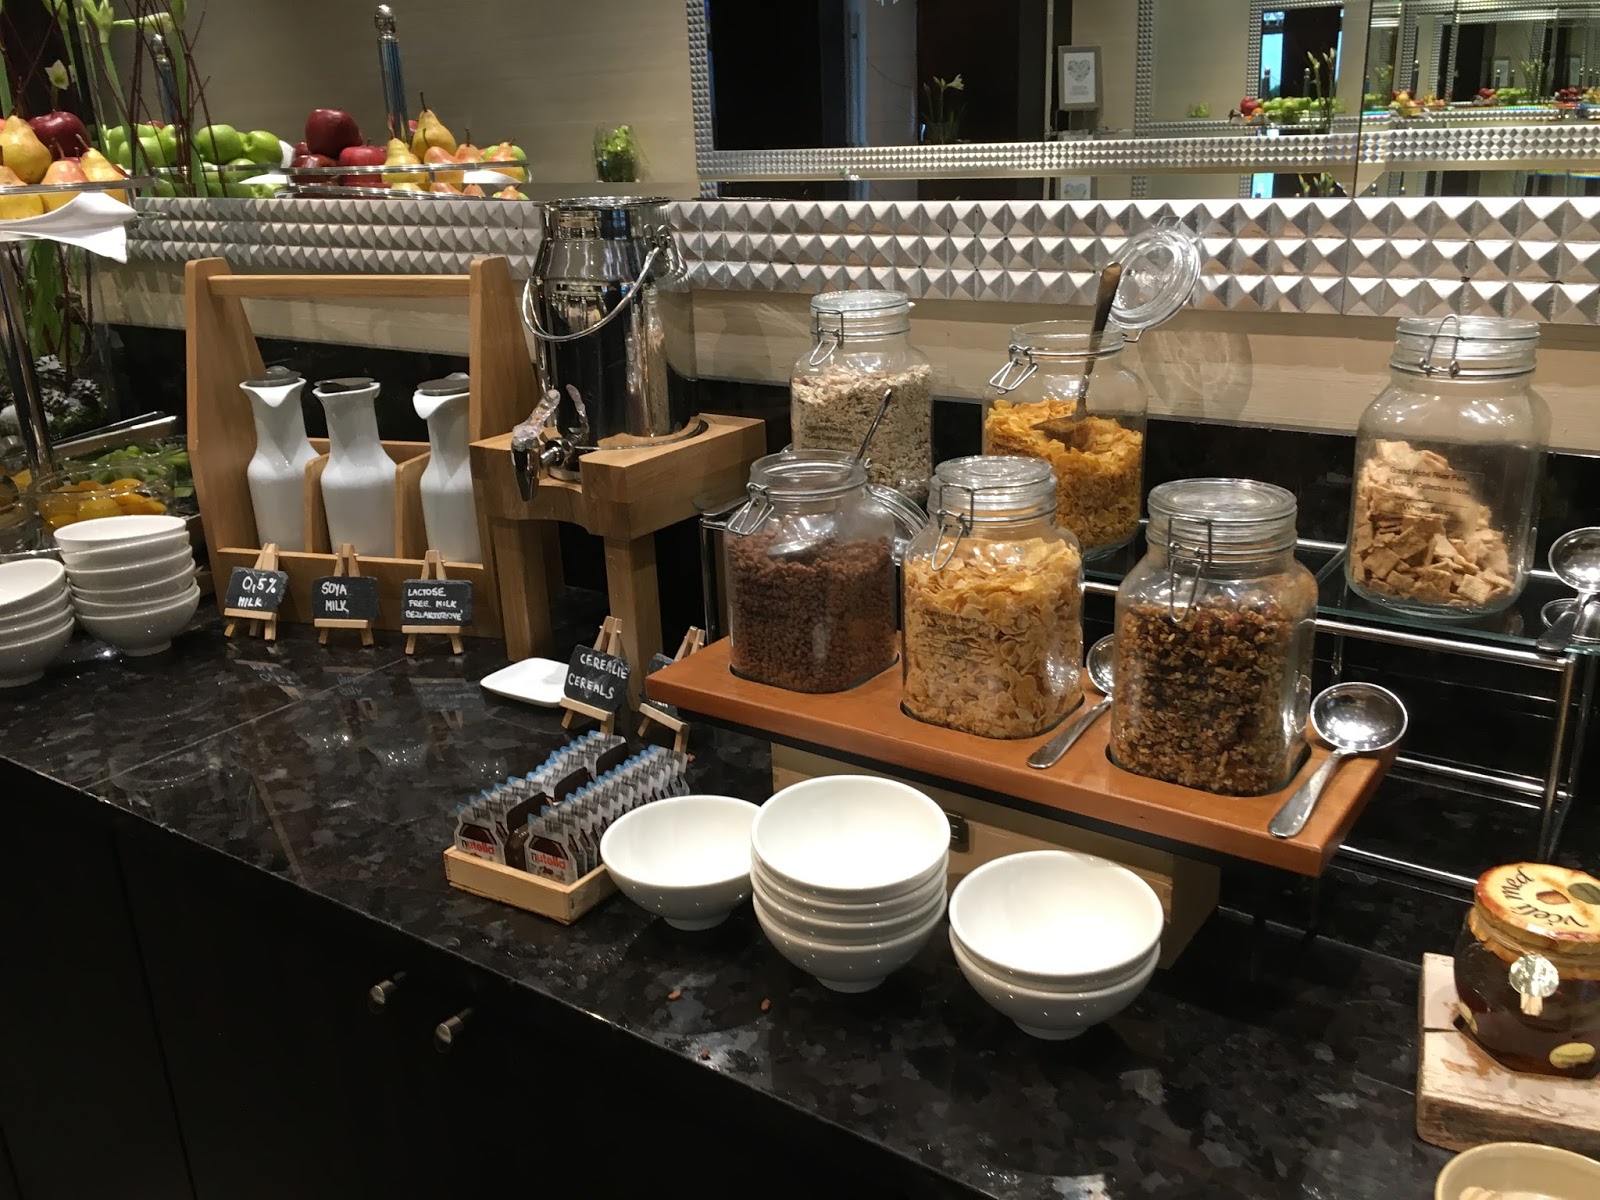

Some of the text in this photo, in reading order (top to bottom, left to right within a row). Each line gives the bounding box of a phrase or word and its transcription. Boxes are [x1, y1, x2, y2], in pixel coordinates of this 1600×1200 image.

[321, 581, 347, 596] SOYA
[407, 586, 447, 597] LACTOSE
[237, 596, 263, 608] MILK
[325, 599, 350, 614] MILK
[408, 599, 458, 609] FREE MILK
[567, 672, 615, 700] CEREALS
[461, 839, 495, 856] nutella
[531, 852, 566, 870] nutella
[1501, 865, 1535, 901] med
